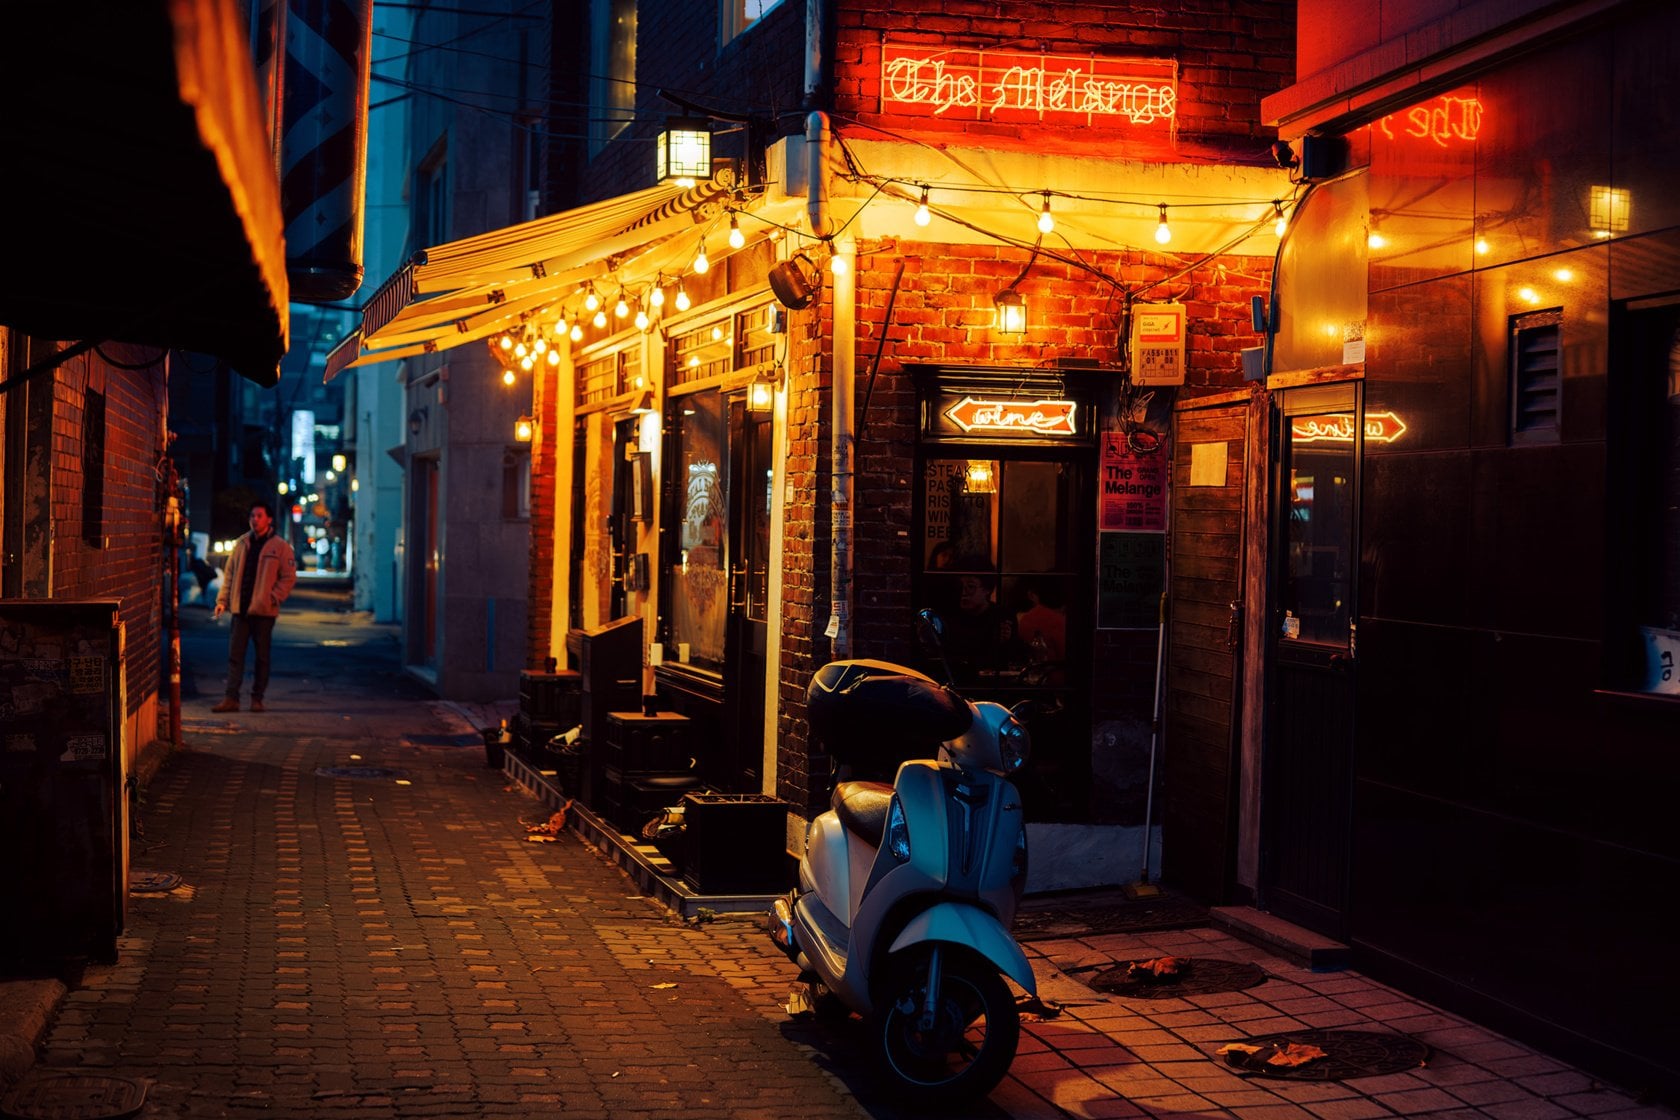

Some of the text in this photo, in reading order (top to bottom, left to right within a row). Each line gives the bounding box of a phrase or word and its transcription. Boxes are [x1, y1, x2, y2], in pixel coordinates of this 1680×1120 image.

[887, 57, 1176, 124] The Melange
[972, 404, 1066, 428] wine
[928, 464, 972, 477] STEAK
[1105, 465, 1133, 480] The
[1105, 481, 1161, 498] Melange
[928, 510, 955, 523] WIN
[1103, 564, 1130, 579] The
